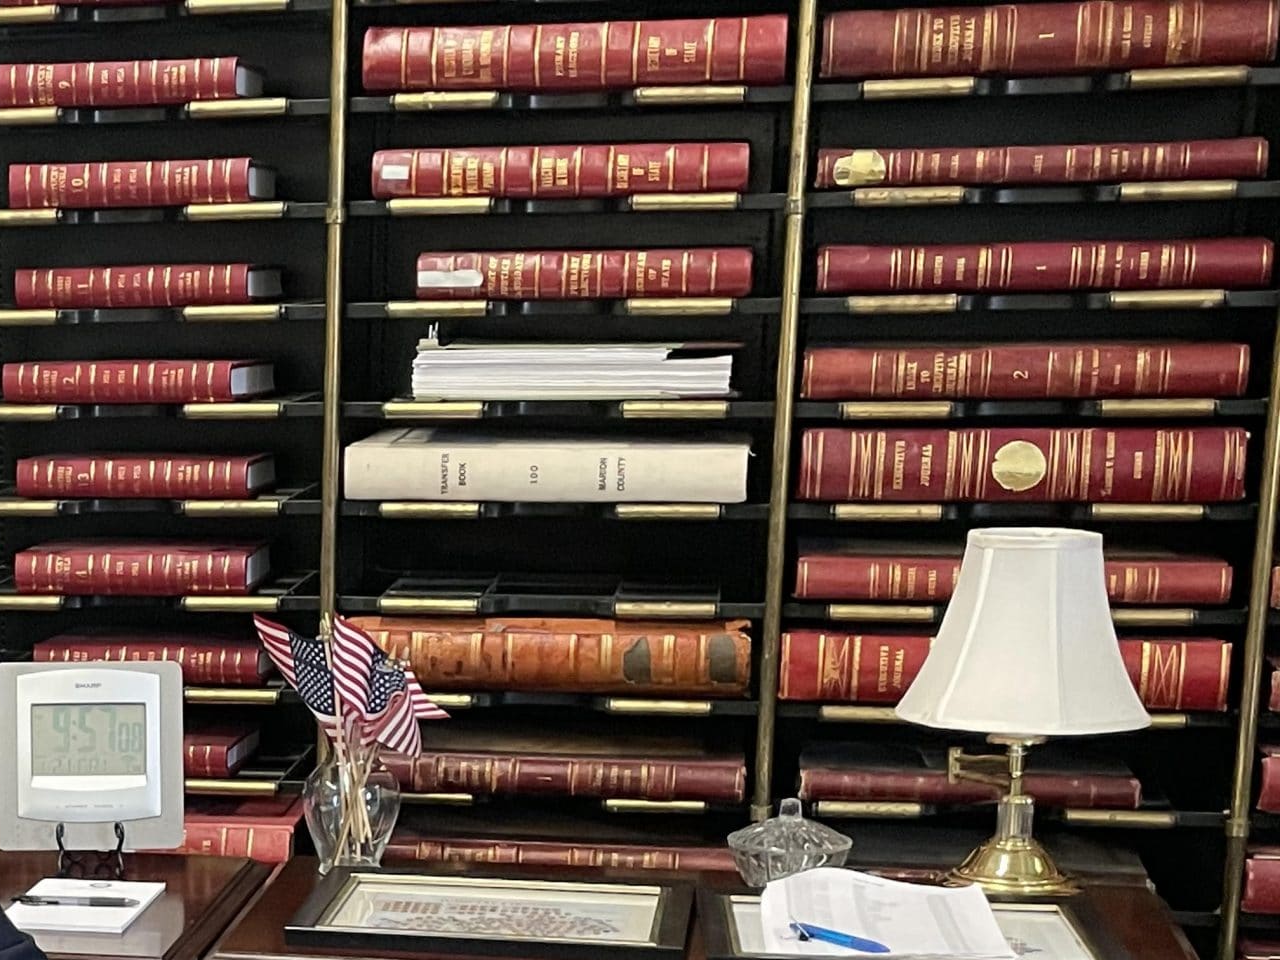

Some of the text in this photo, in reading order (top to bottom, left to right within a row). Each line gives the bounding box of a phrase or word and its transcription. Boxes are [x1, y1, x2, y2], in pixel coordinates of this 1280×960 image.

[933, 18, 944, 30] TO
[683, 41, 697, 62] STATE
[648, 161, 661, 181] STATE
[648, 268, 657, 280] OF
[661, 259, 672, 287] STATE
[921, 370, 930, 383] TO
[1013, 370, 1029, 380] 2
[441, 453, 450, 495] TRANSFER
[458, 462, 467, 486] BOOK
[529, 465, 539, 484] 100
[598, 457, 608, 491] MARION
[616, 457, 626, 491] COUNTY
[892, 441, 905, 490] EXECUTIVE
[920, 444, 933, 487] JOURNAL
[893, 648, 904, 688] JOURNAL
